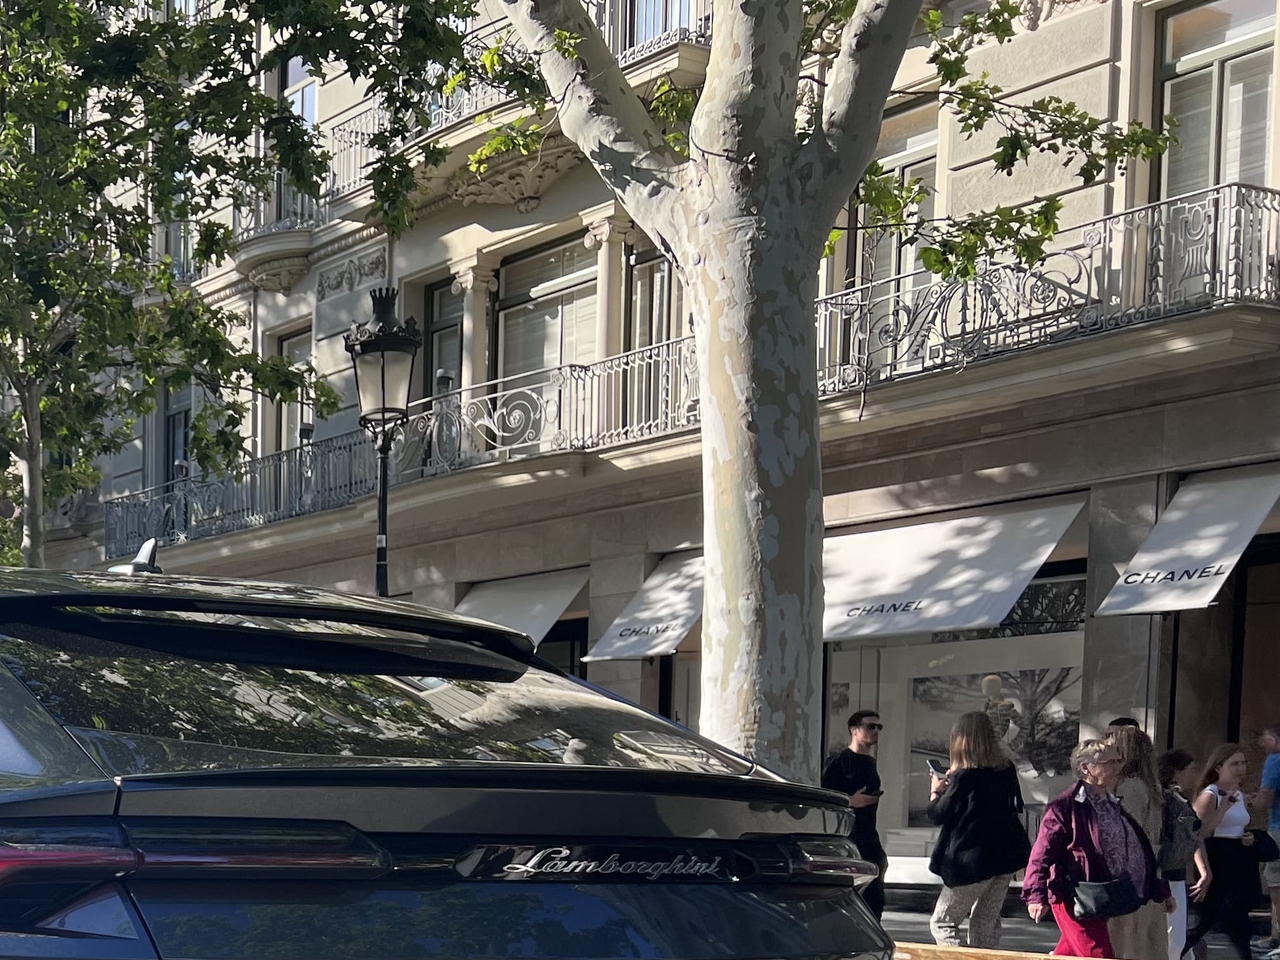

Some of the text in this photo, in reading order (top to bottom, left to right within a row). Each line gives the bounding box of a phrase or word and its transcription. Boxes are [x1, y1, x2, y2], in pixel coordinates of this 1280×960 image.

[1124, 564, 1227, 585] CHANEL
[846, 600, 923, 617] CHANEL
[619, 622, 679, 637] CHANEL
[503, 848, 721, 880] Lamborghini
